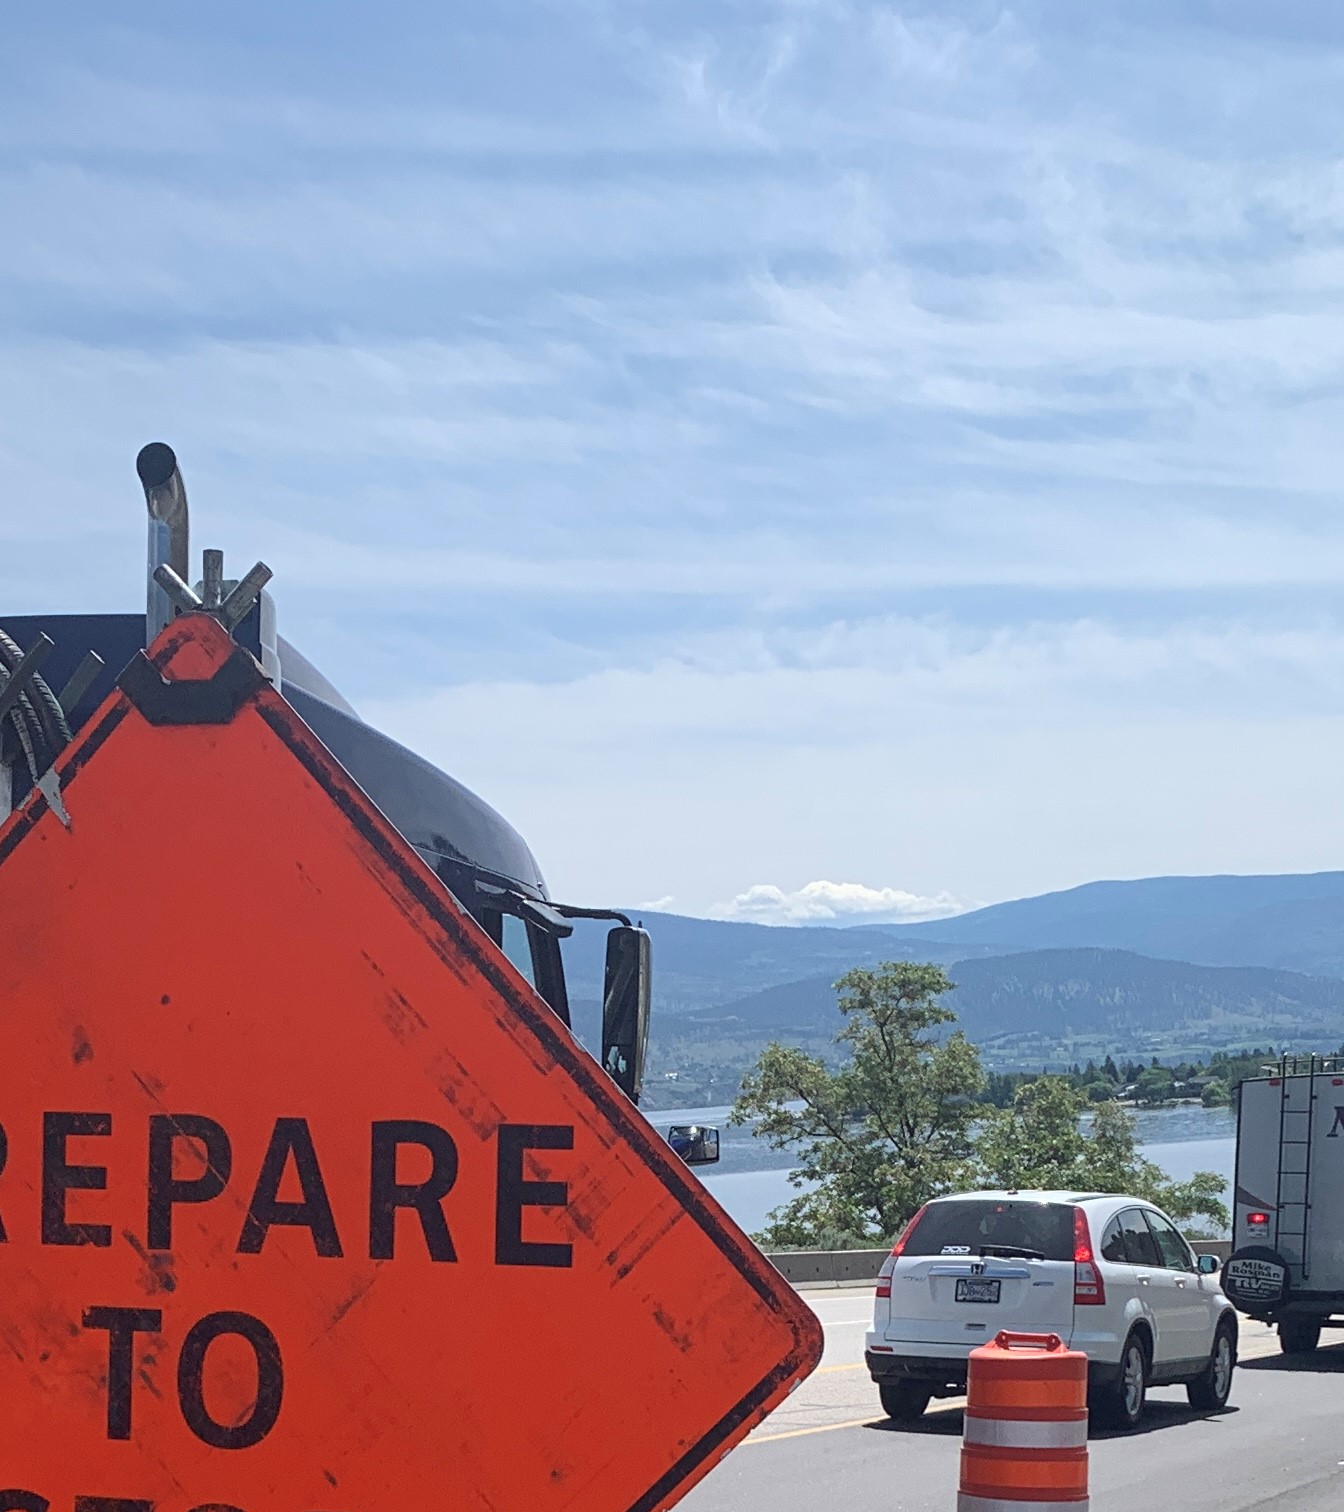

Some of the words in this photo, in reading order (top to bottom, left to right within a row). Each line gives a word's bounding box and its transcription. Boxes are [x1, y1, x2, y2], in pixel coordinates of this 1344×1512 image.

[1232, 1266, 1280, 1279] Rosman
[1242, 1261, 1271, 1272] Mike
[81, 1305, 284, 1450] TO
